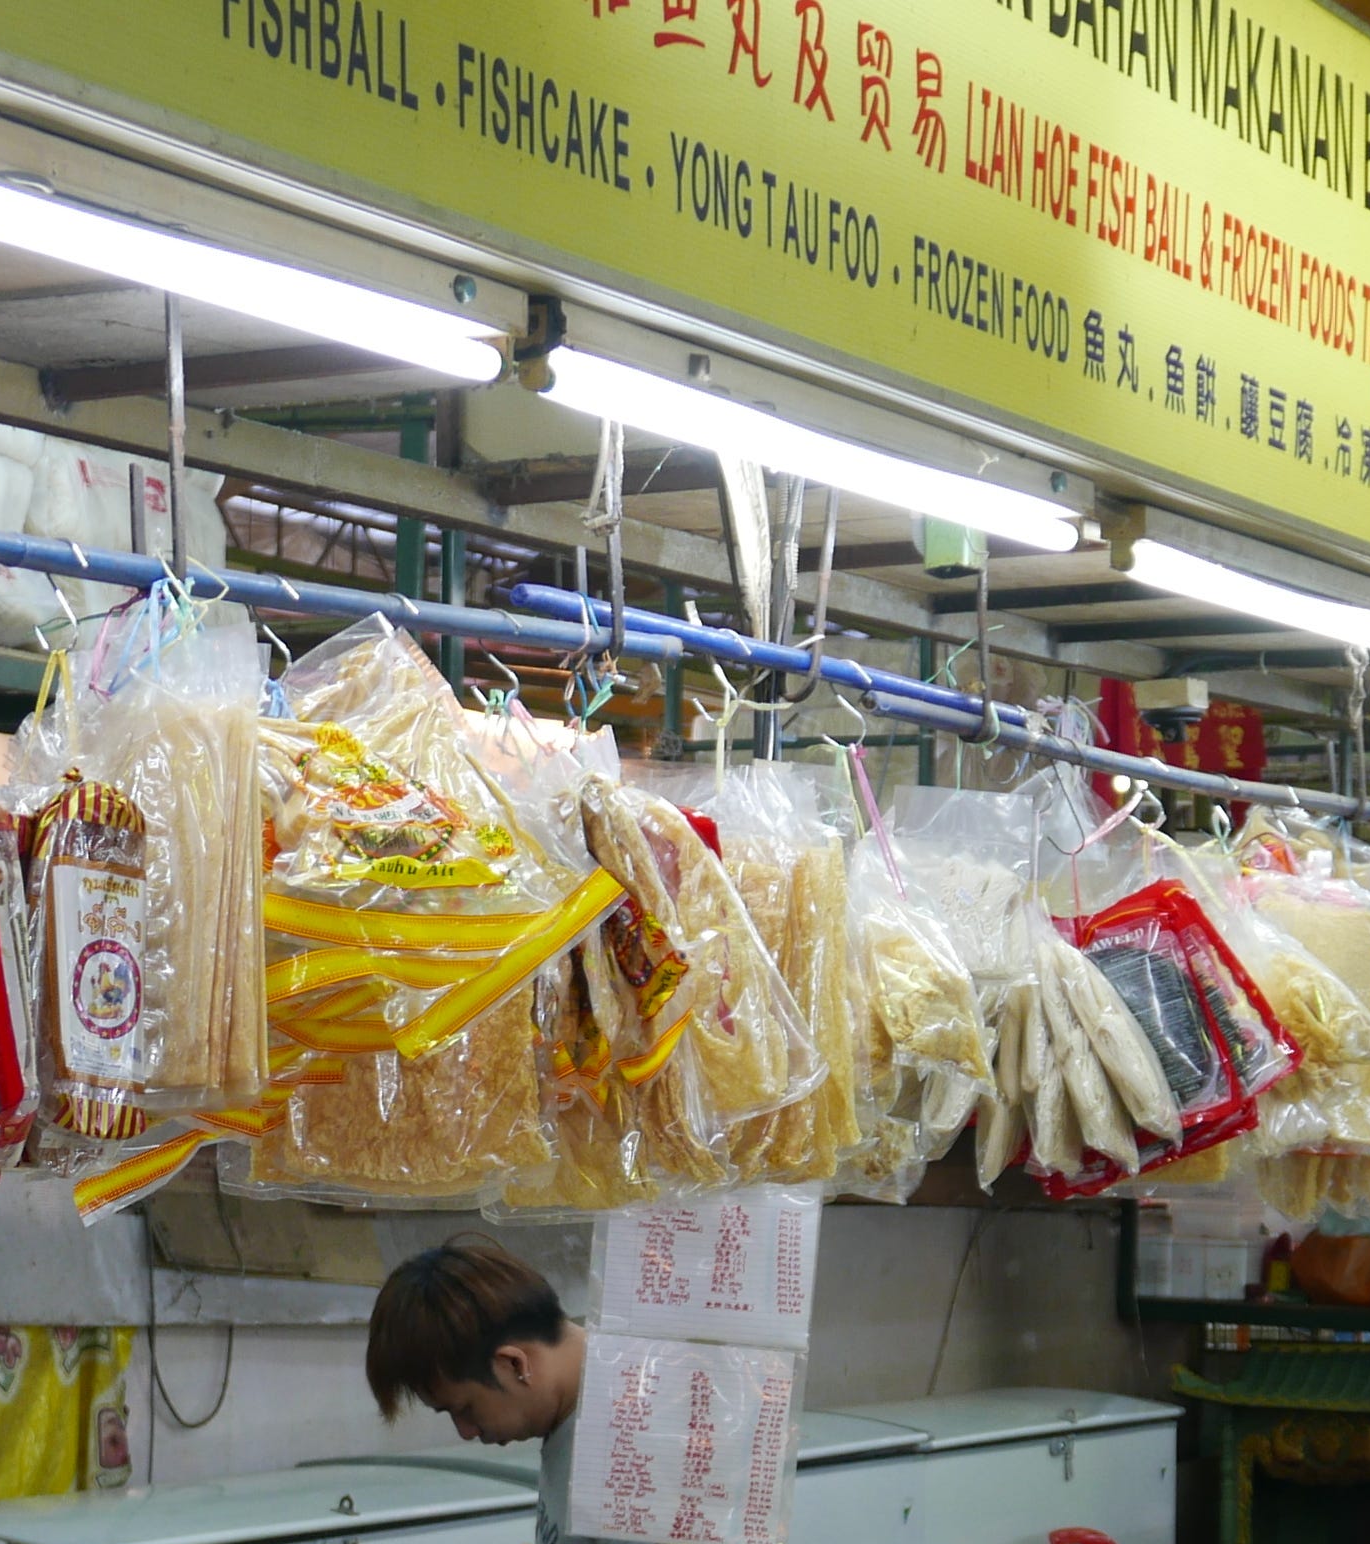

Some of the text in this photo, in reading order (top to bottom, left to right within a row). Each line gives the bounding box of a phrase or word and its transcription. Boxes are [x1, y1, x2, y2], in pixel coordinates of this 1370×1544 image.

[459, 42, 629, 191] FISHCAKE
[670, 131, 751, 238] YONG
[762, 169, 818, 264] TAU
[829, 198, 879, 288] FOO
[914, 235, 1004, 340] FROZEN
[1013, 277, 1069, 363] FOOD
[965, 80, 1024, 201] LIAN
[1031, 114, 1081, 227] HOE
[1086, 143, 1137, 256] FISH
[1144, 172, 1192, 282] BALL
[1200, 200, 1214, 291] &
[1221, 211, 1291, 327] FROZEN
[1298, 252, 1356, 356] FOODS
[1191, 0, 1353, 199] MAKANAN
